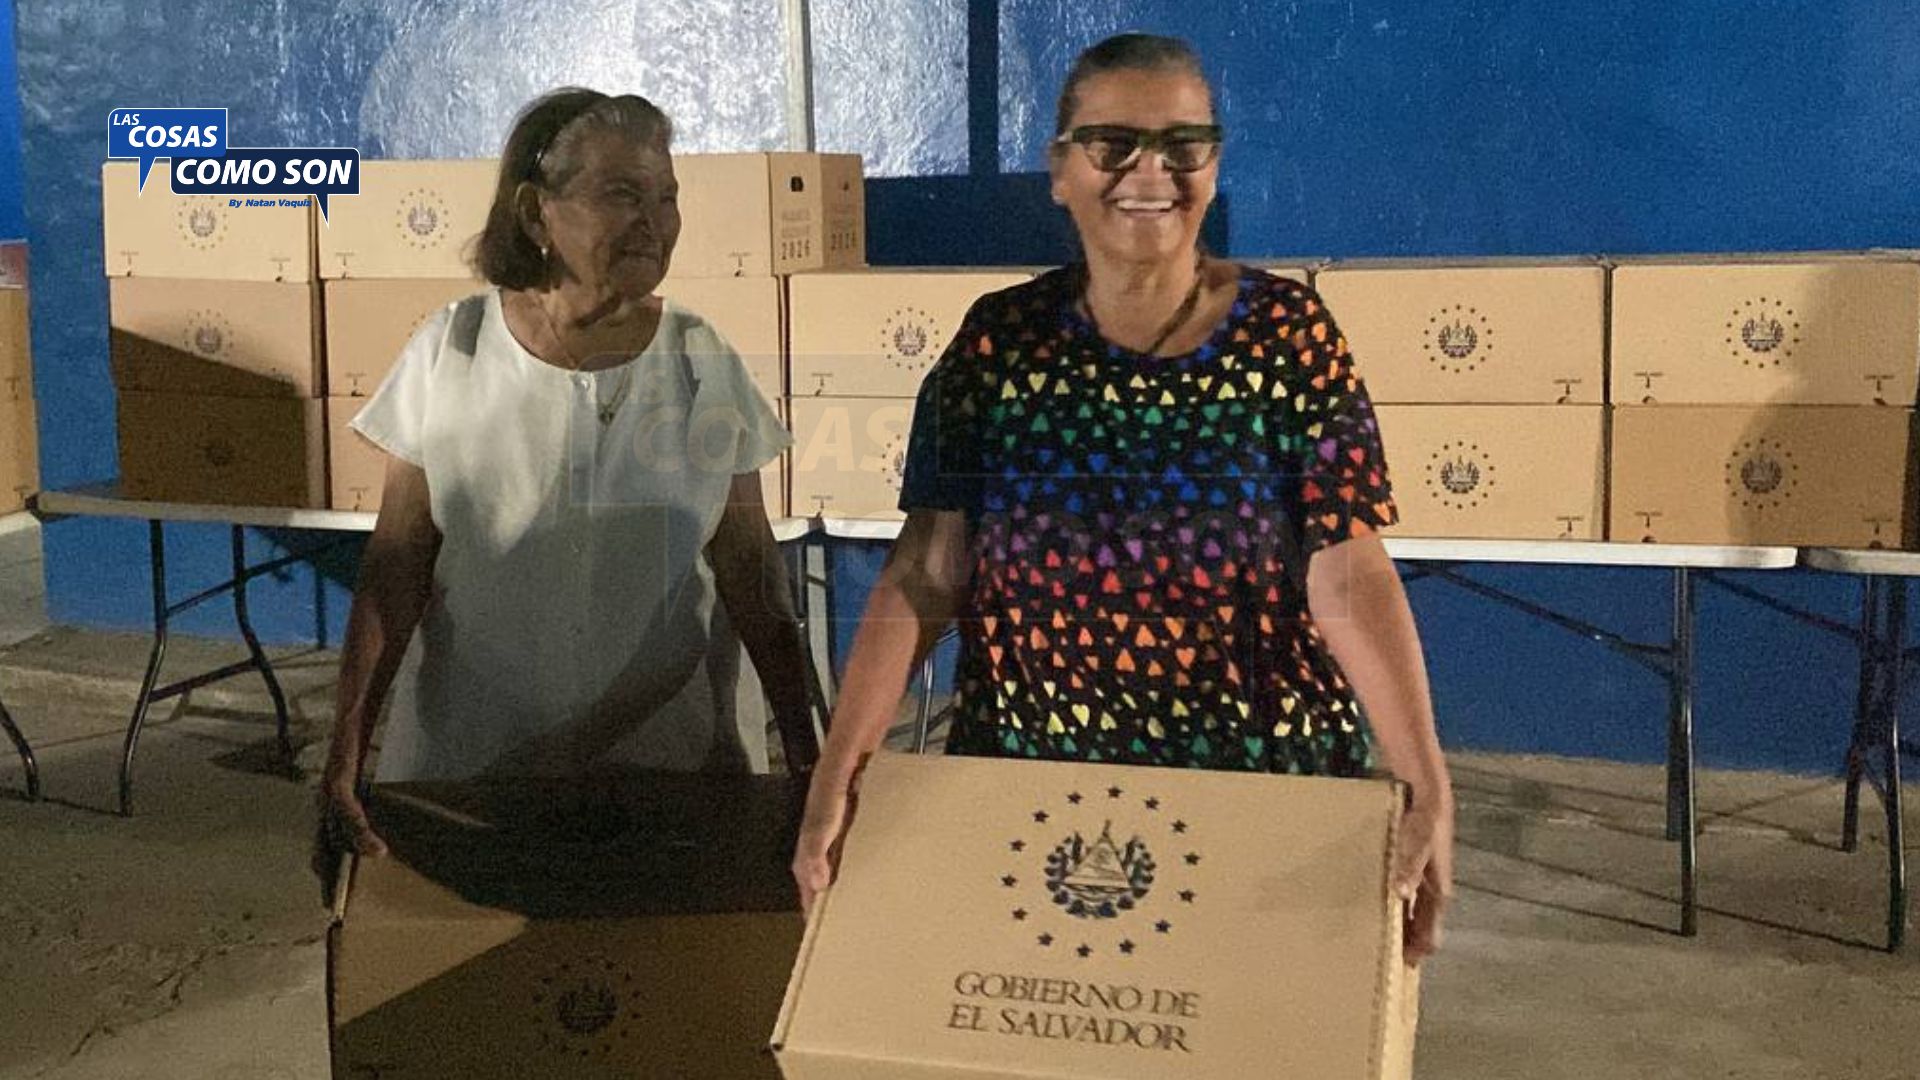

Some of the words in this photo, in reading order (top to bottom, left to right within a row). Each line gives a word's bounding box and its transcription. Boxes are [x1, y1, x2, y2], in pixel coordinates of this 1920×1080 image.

[953, 970, 1144, 1013] GOBIERNO
[1149, 987, 1201, 1020] DE
[946, 1003, 989, 1033] EL
[998, 1007, 1192, 1054] SALVADOR
